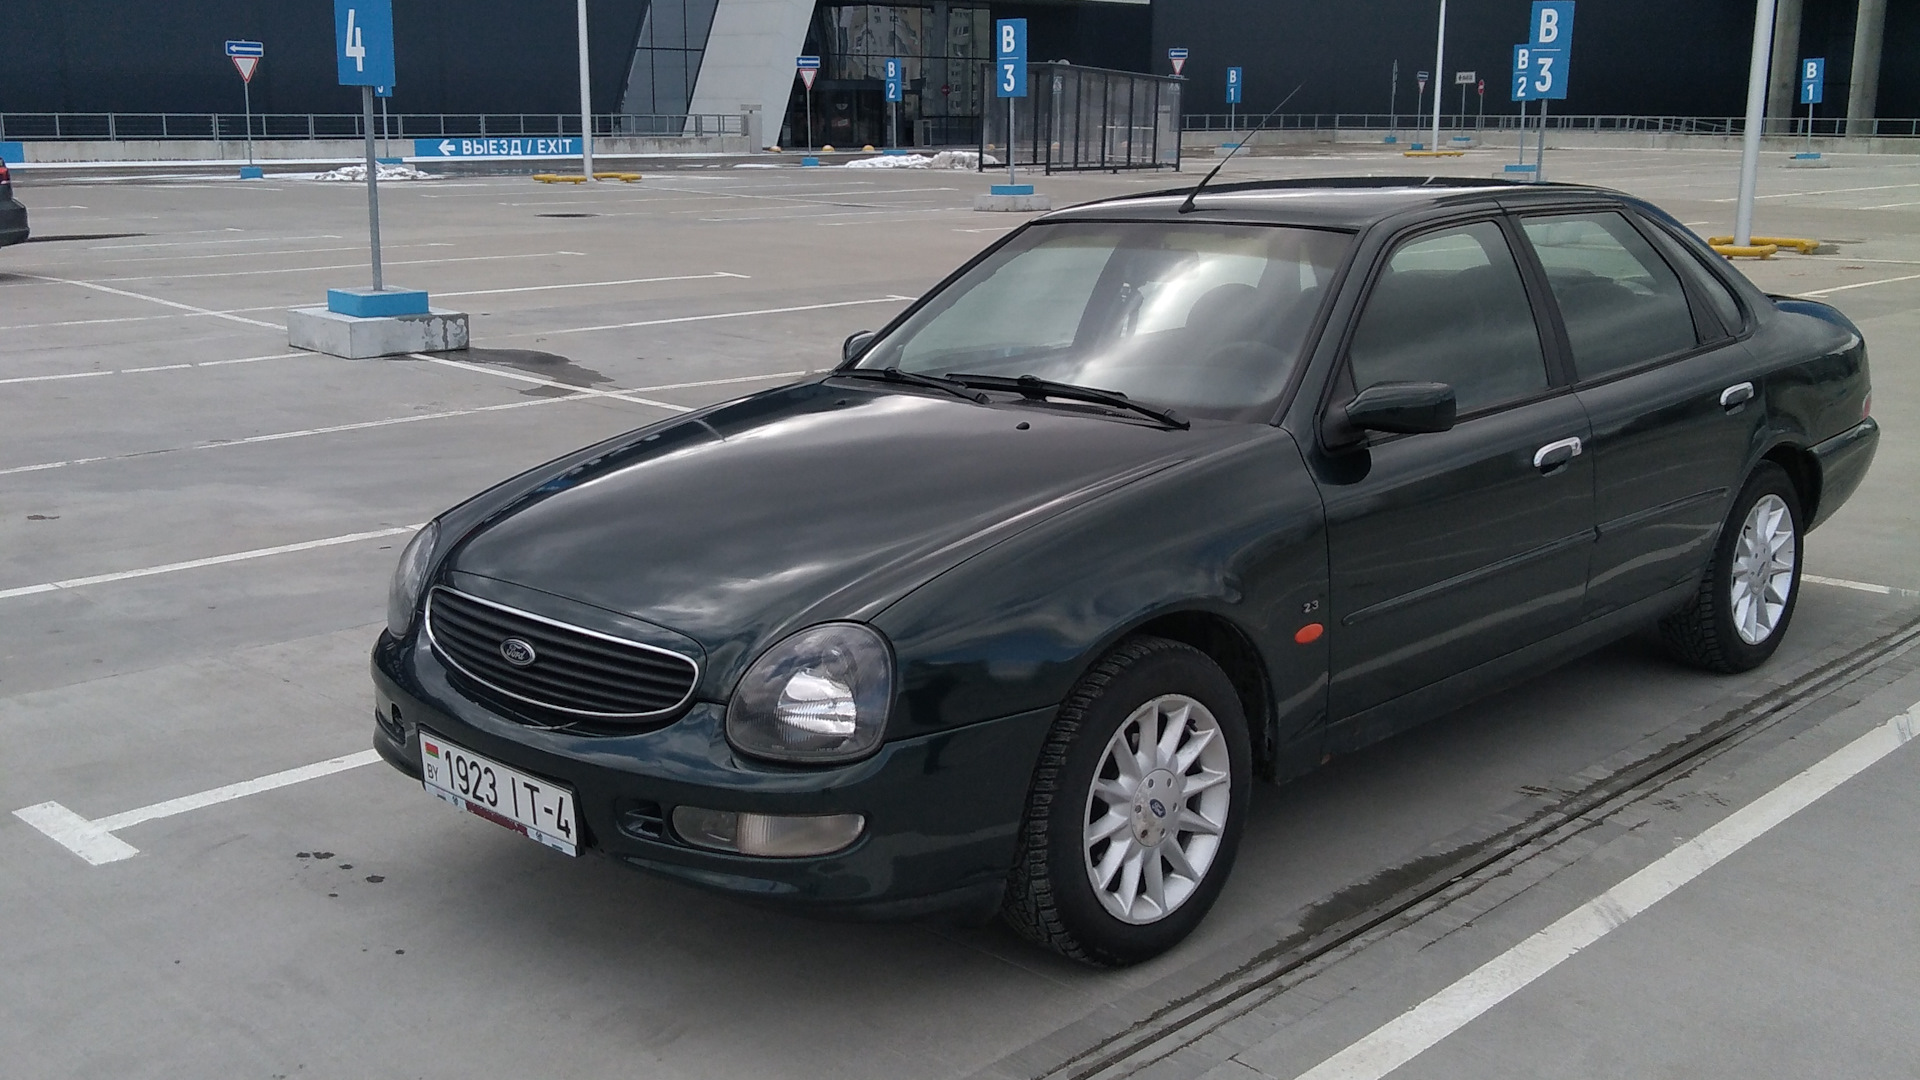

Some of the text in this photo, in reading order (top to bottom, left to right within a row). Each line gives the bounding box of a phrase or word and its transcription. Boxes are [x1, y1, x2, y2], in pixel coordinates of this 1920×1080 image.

[1539, 8, 1559, 43] B
[346, 8, 366, 72] 4
[1002, 25, 1015, 53] B
[1518, 48, 1529, 70] B
[887, 61, 896, 78] B
[1003, 64, 1015, 92] 3
[1229, 69, 1237, 84] B
[1535, 57, 1553, 92] 3
[1806, 62, 1817, 79] B
[888, 82, 896, 99] 2
[1229, 87, 1235, 101] 1
[1516, 76, 1528, 97] 2
[1806, 83, 1814, 101] 1
[462, 140, 522, 155] ВЫЕЗД
[537, 139, 573, 154] EXIT
[426, 763, 440, 782] BY
[445, 750, 499, 808] 1923
